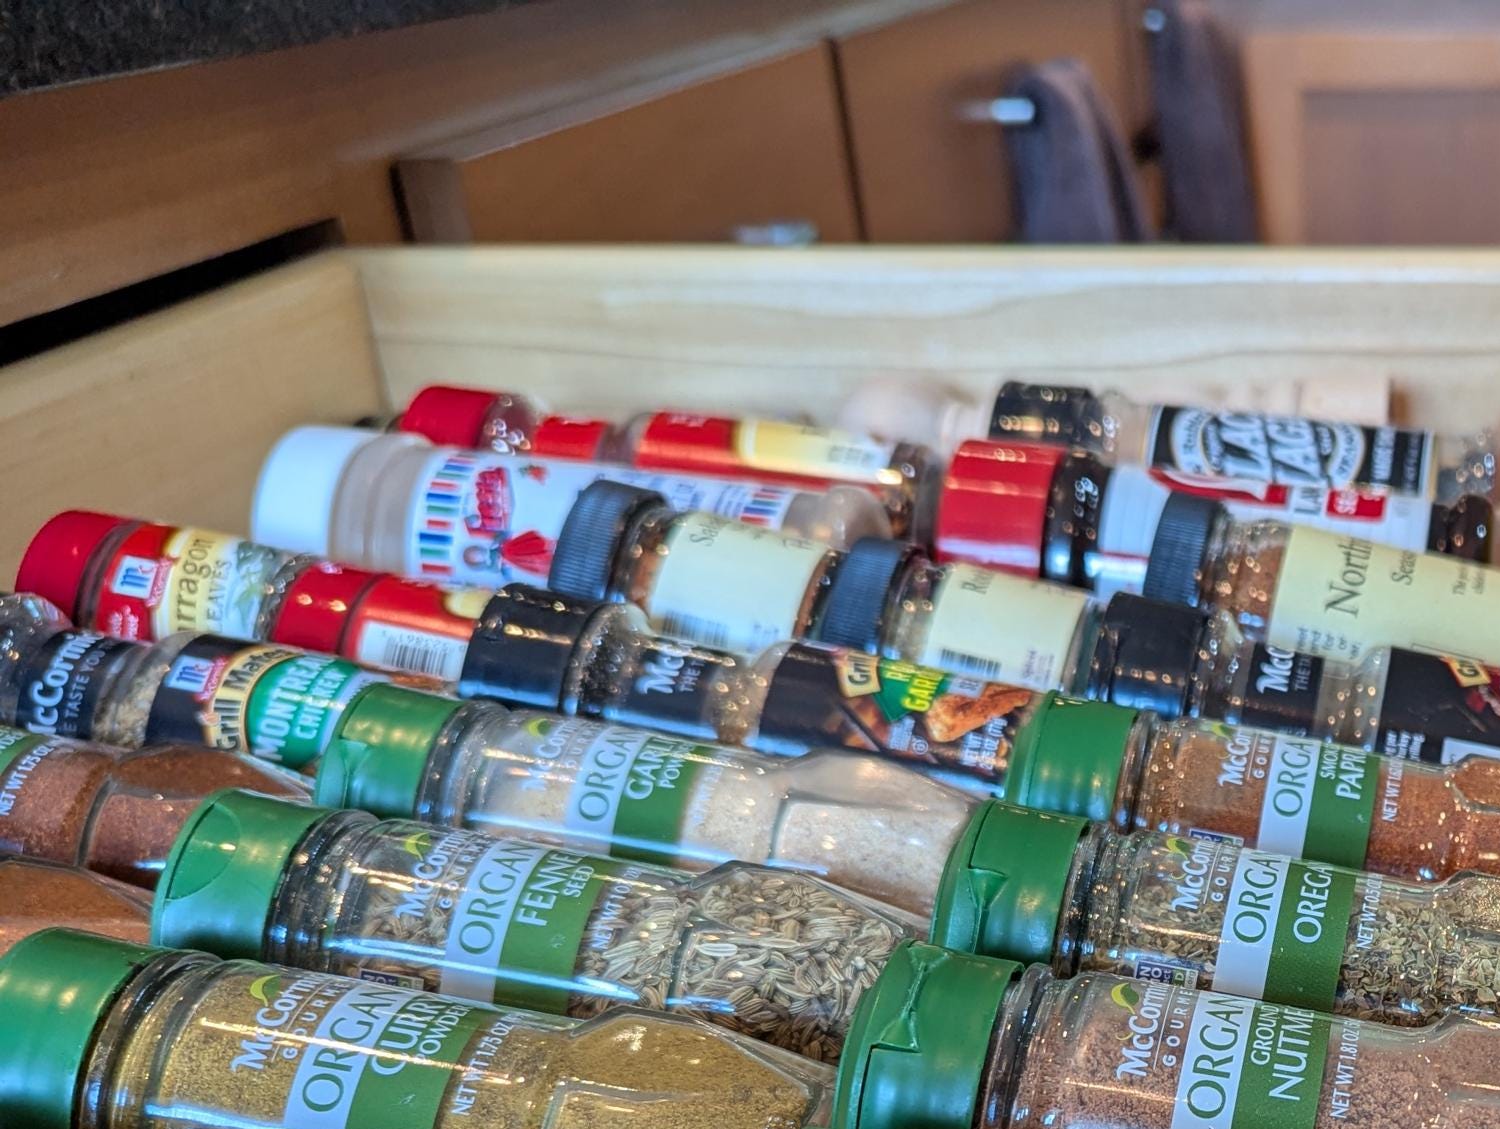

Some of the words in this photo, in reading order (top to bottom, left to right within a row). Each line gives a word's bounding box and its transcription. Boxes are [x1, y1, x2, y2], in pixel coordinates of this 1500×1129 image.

[1382, 799, 1399, 821] NET
[562, 865, 594, 898] SEED
[1362, 902, 1378, 924] WT
[592, 921, 615, 949] NET
[1357, 926, 1374, 949] NET
[1251, 1004, 1280, 1066] GROUND
[1342, 1042, 1357, 1065] 1.81
[451, 1090, 475, 1116] NET
[463, 1060, 485, 1090] WT
[1337, 1066, 1354, 1093] WT
[1331, 1095, 1350, 1119] NET
